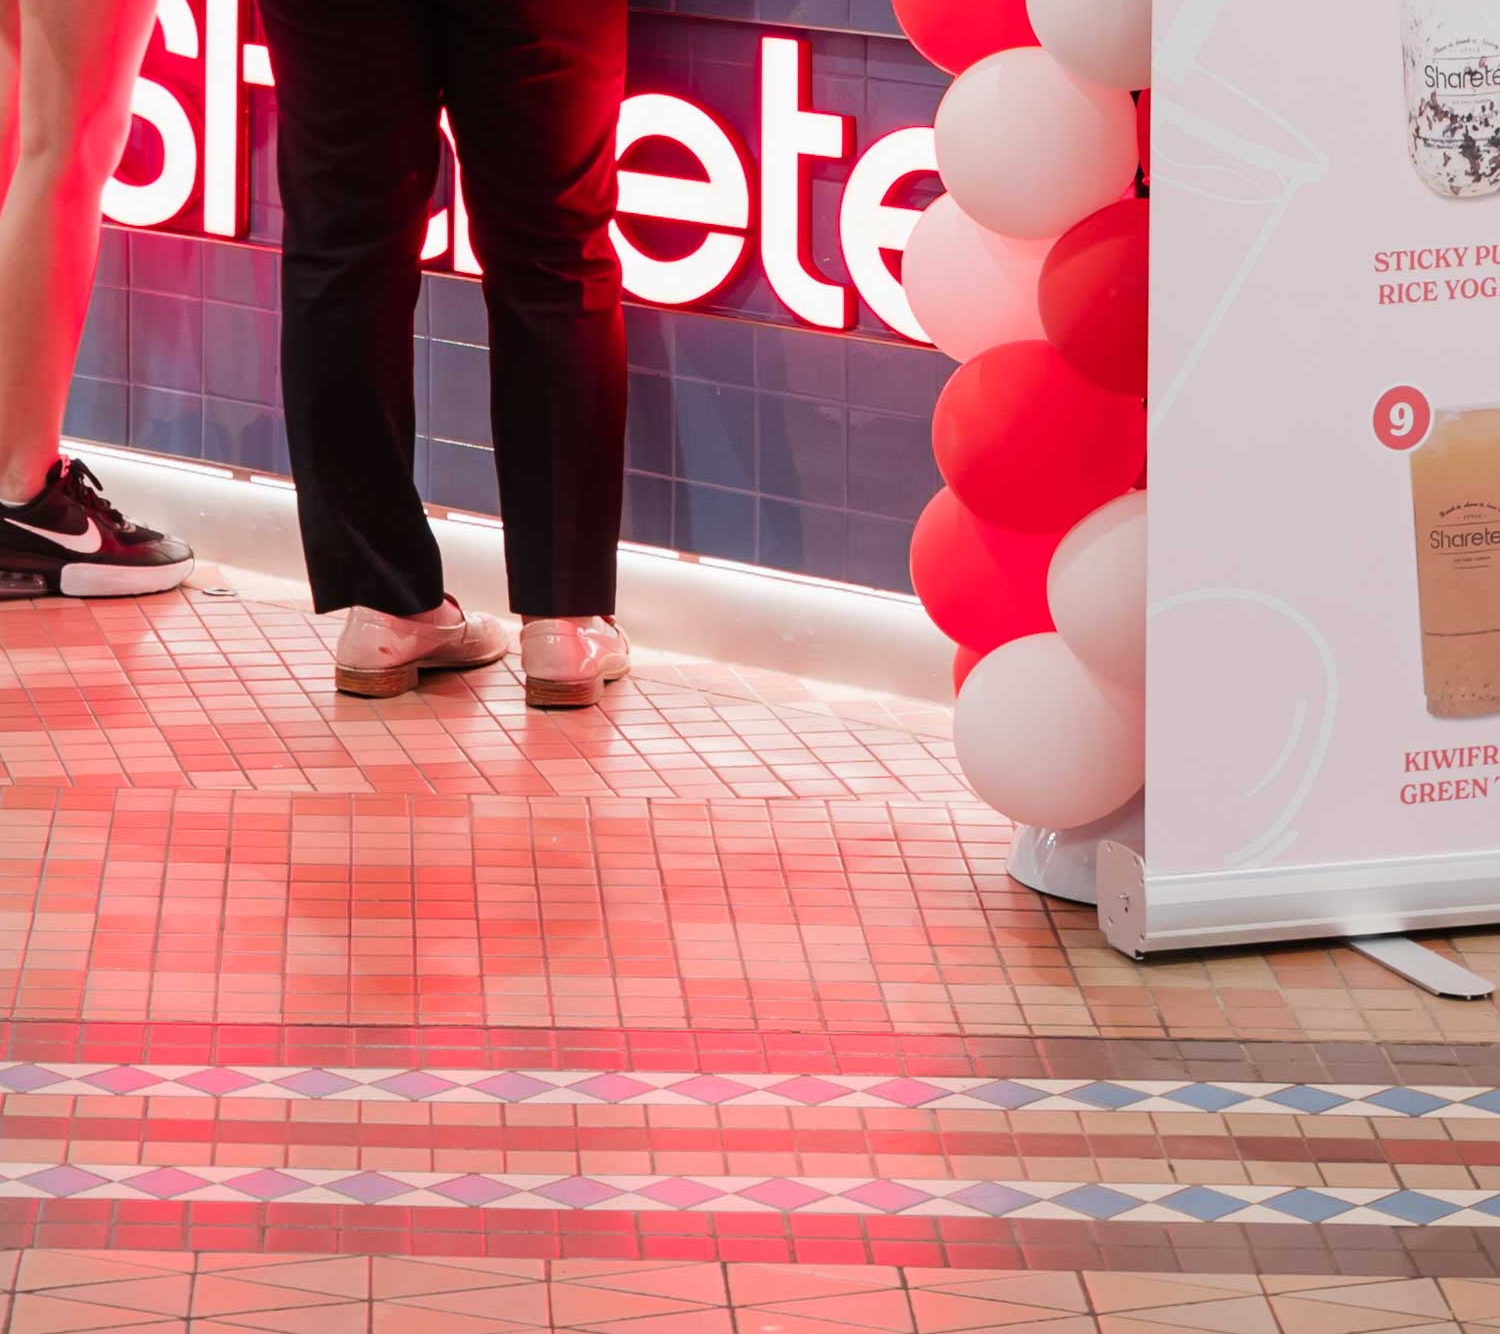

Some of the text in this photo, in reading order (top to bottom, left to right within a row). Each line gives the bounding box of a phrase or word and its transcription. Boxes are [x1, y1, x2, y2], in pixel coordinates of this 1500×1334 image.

[1373, 247, 1468, 273] STICKY
[1378, 281, 1436, 305] RICE
[1389, 402, 1415, 437] 9
[1399, 778, 1489, 805] GREEN
